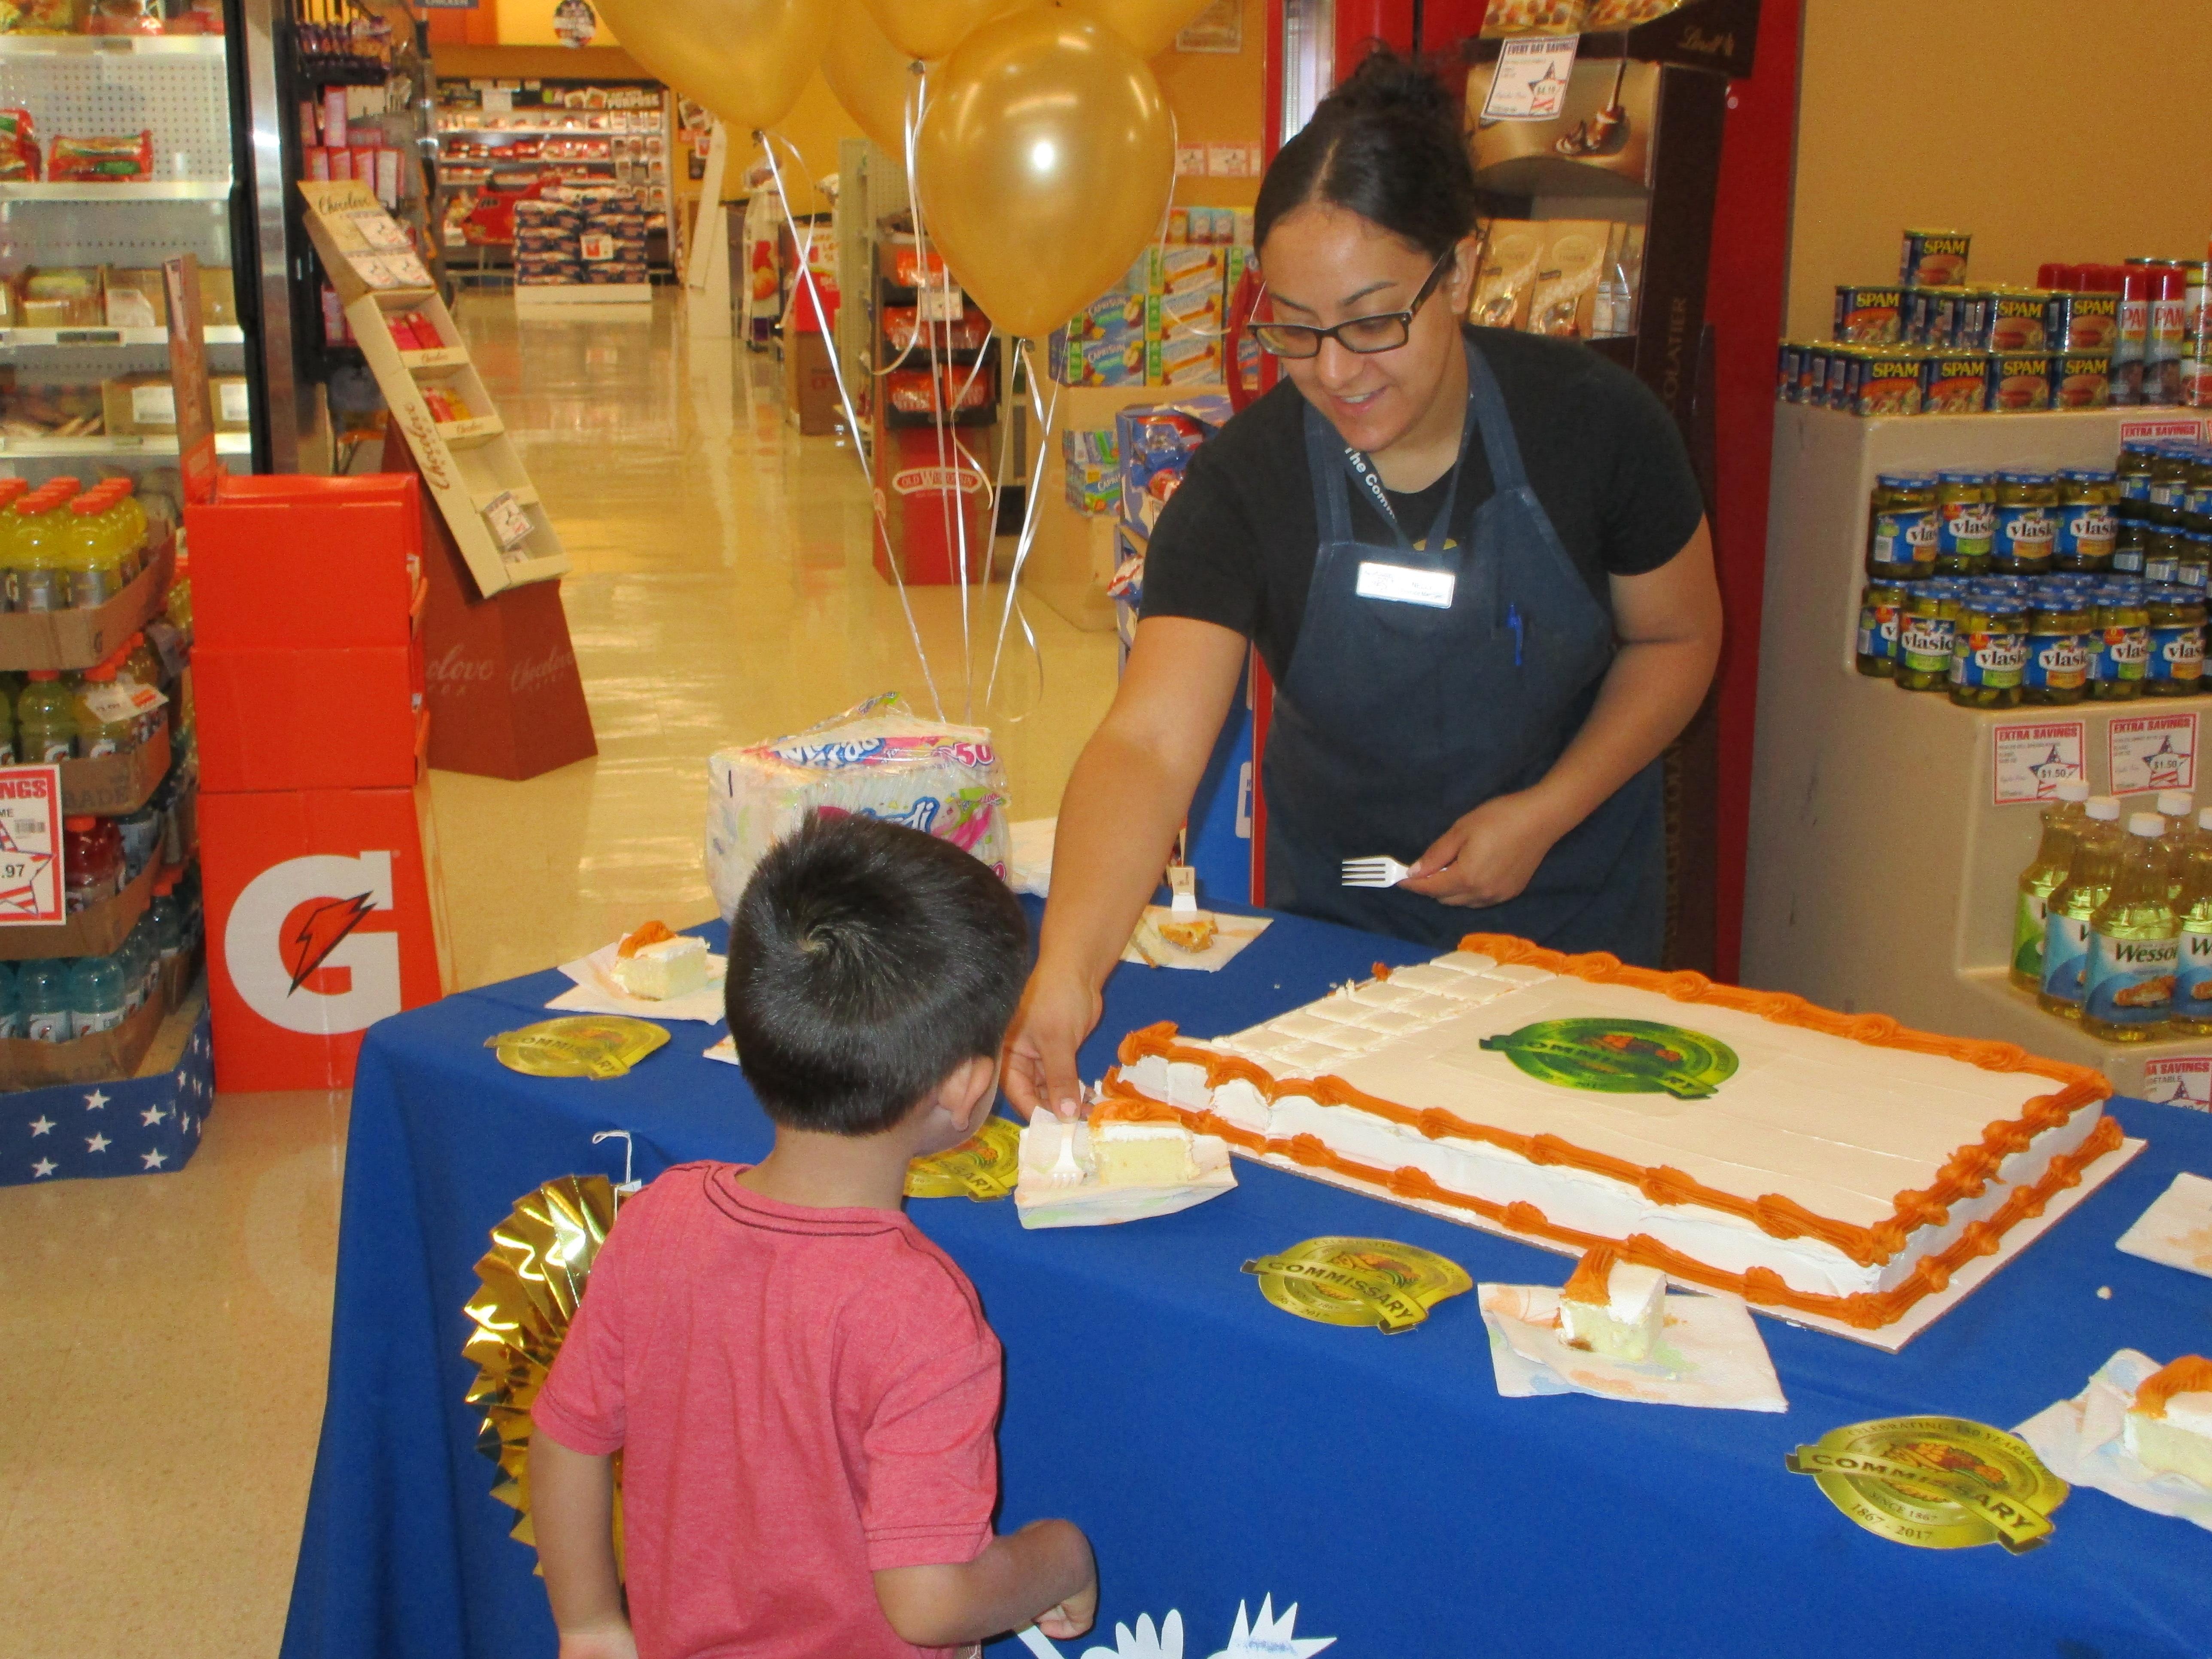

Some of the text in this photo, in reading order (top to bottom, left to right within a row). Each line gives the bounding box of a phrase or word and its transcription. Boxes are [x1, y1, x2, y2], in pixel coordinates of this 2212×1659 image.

[1923, 240, 1965, 254] SPAM
[1856, 293, 1899, 307] SPAM
[2074, 300, 2115, 315] SPAM
[1999, 301, 2043, 318] SPAM
[1872, 362, 1919, 377] SPAM
[1942, 362, 1985, 377] SPAM
[2003, 360, 2047, 375] SPAM
[2064, 359, 2108, 374] SPAM
[2125, 425, 2196, 438] EXTRA SAVINGS
[902, 475, 920, 488] OLD
[2114, 718, 2191, 734] EXTRA SAVINGS
[1999, 727, 2077, 741] EXTRA SAVINGS
[2154, 760, 2178, 769] $1.50
[2041, 769, 2066, 778] $1.50
[225, 850, 402, 1035] G
[2192, 937, 2212, 956] W
[2160, 1062, 2210, 1075] SAVINGS
[1268, 1261, 1415, 1320] COMMISSARY
[1850, 1503, 1884, 1524] 1867
[1896, 1525, 1932, 1541] 2017
